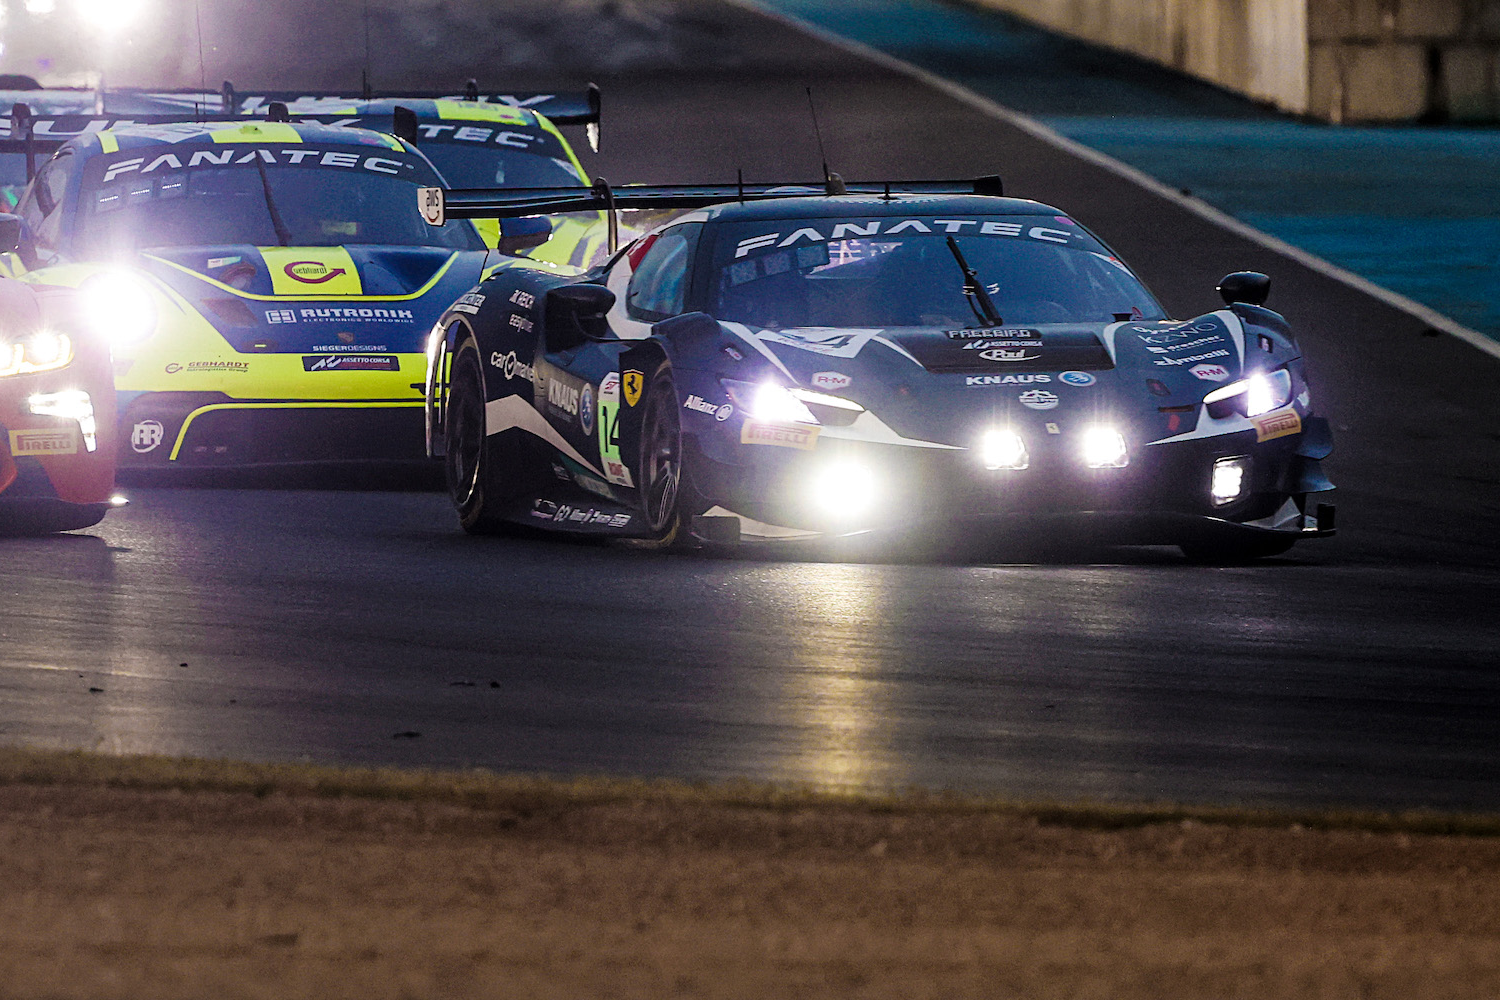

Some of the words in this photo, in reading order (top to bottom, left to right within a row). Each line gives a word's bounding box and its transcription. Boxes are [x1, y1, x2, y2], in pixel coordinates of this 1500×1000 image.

[418, 123, 535, 149] TEC
[103, 149, 403, 183] FANATEC
[734, 219, 1071, 259] FANATEC
[299, 308, 414, 319] RUTRONIK
[965, 374, 1052, 386] KNAUS
[548, 378, 579, 416] KNAUS
[684, 394, 719, 415] Allianz
[16, 433, 72, 451] PIRELLI
[747, 422, 812, 444] PIRELLI
